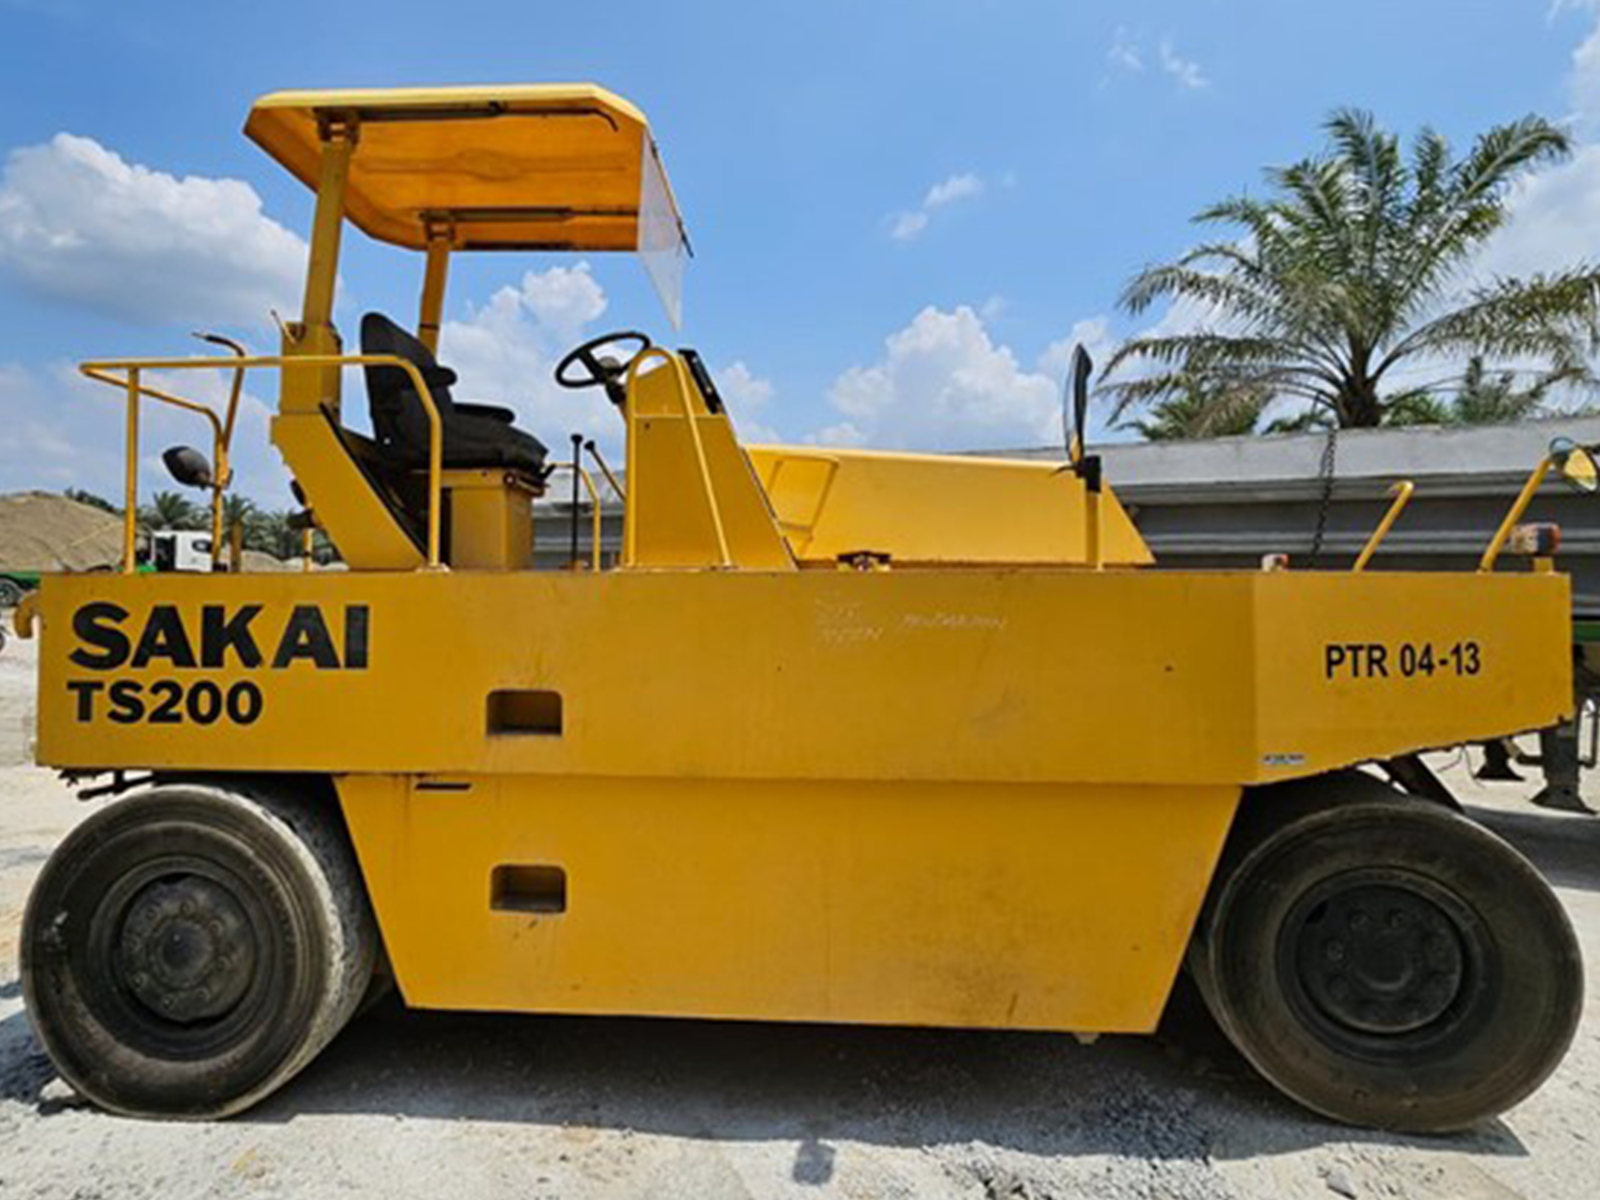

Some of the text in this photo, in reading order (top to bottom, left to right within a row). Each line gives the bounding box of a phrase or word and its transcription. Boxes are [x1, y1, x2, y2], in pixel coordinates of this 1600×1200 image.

[69, 602, 370, 671] SAKAI
[1325, 641, 1481, 678] PTR 04-13
[67, 680, 263, 726] TS200
